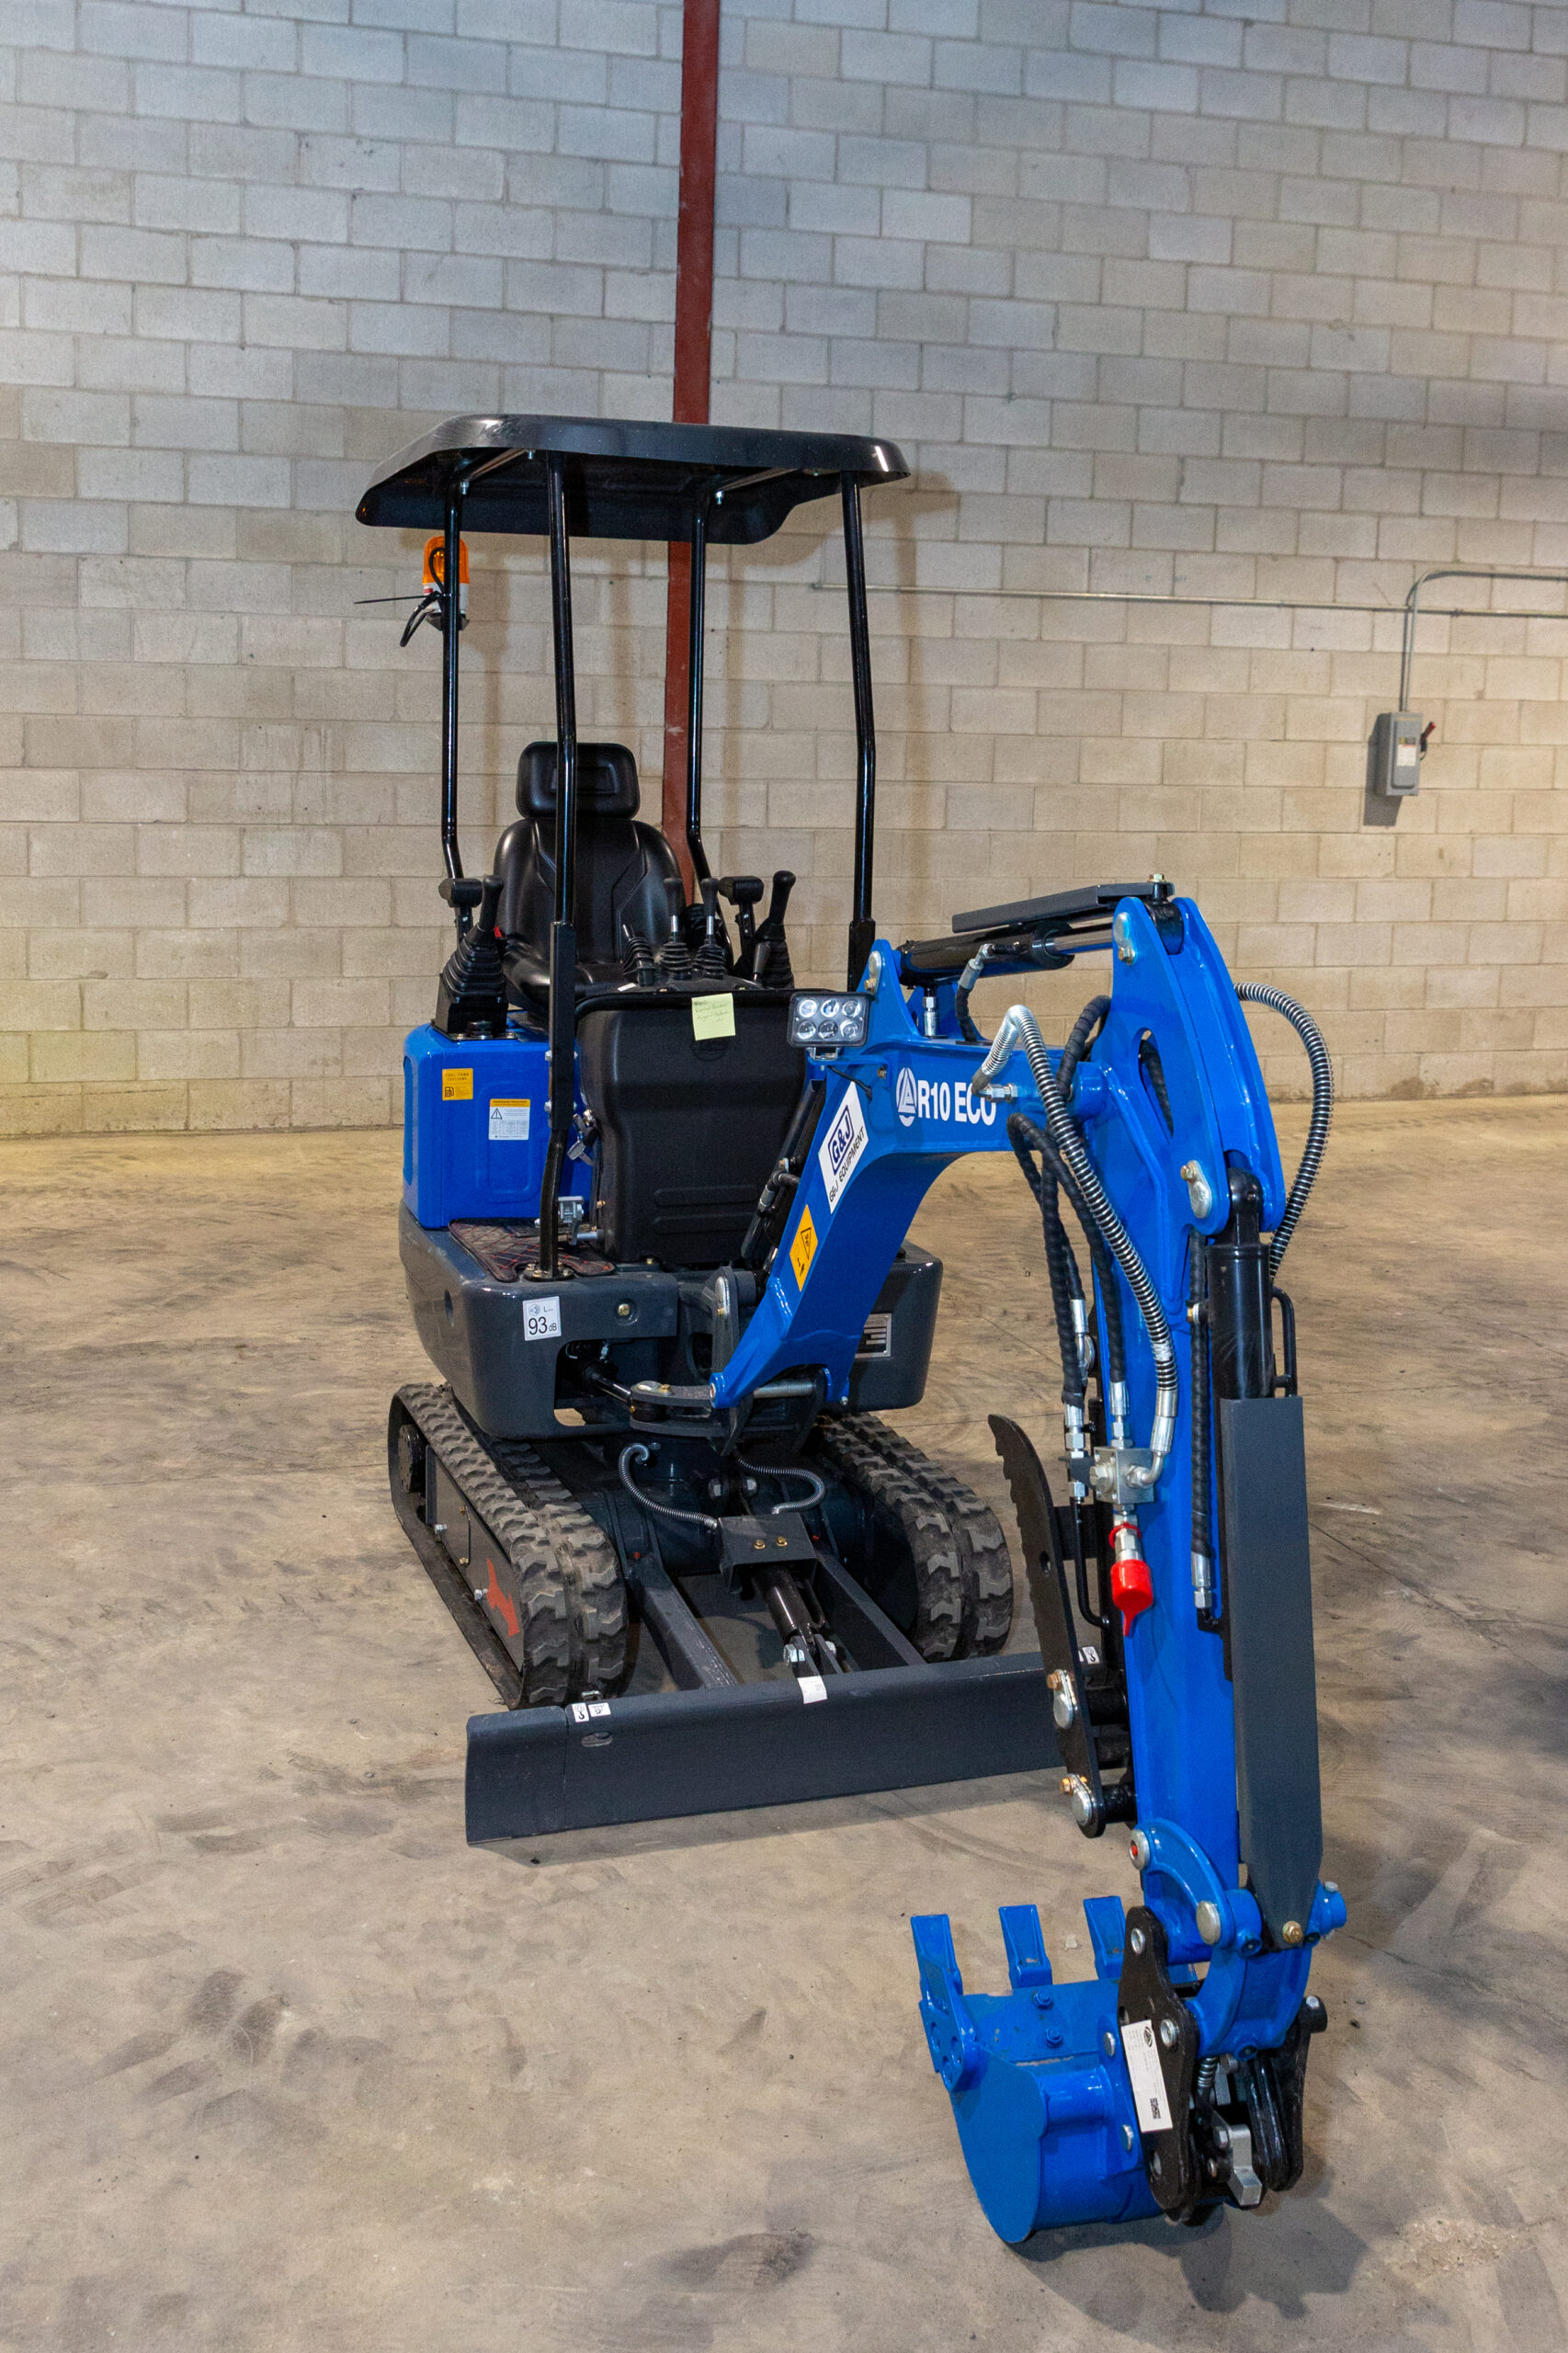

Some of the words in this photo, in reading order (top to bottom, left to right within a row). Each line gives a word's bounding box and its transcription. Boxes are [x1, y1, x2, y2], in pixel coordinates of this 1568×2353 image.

[917, 1079, 951, 1121] R10
[831, 1114, 851, 1164] G&J
[838, 1125, 865, 1182] EQUIPMENT
[528, 1316, 548, 1336] 93
[549, 1323, 558, 1332] dB
